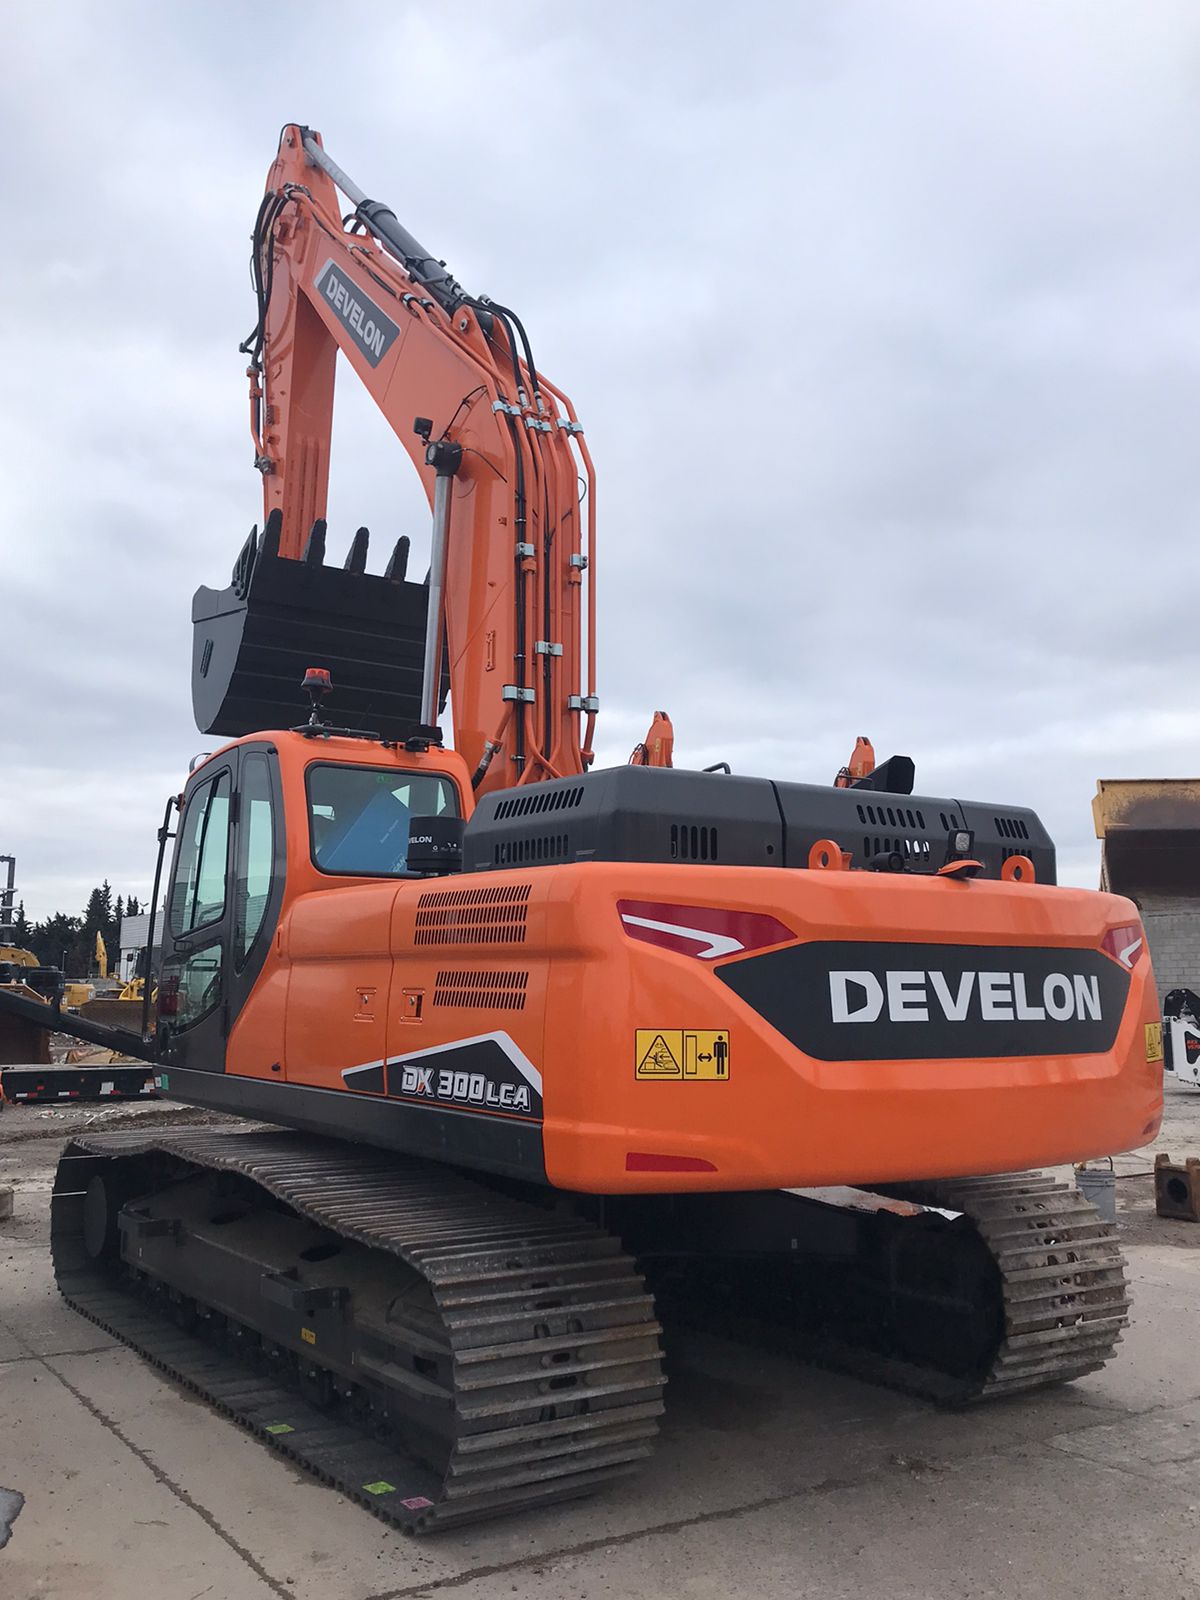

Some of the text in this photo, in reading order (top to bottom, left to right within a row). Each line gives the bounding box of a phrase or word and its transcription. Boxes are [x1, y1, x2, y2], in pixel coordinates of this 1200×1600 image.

[326, 274, 385, 357] DEVELON
[829, 971, 1102, 1022] DEVELON
[402, 1065, 434, 1097] DX
